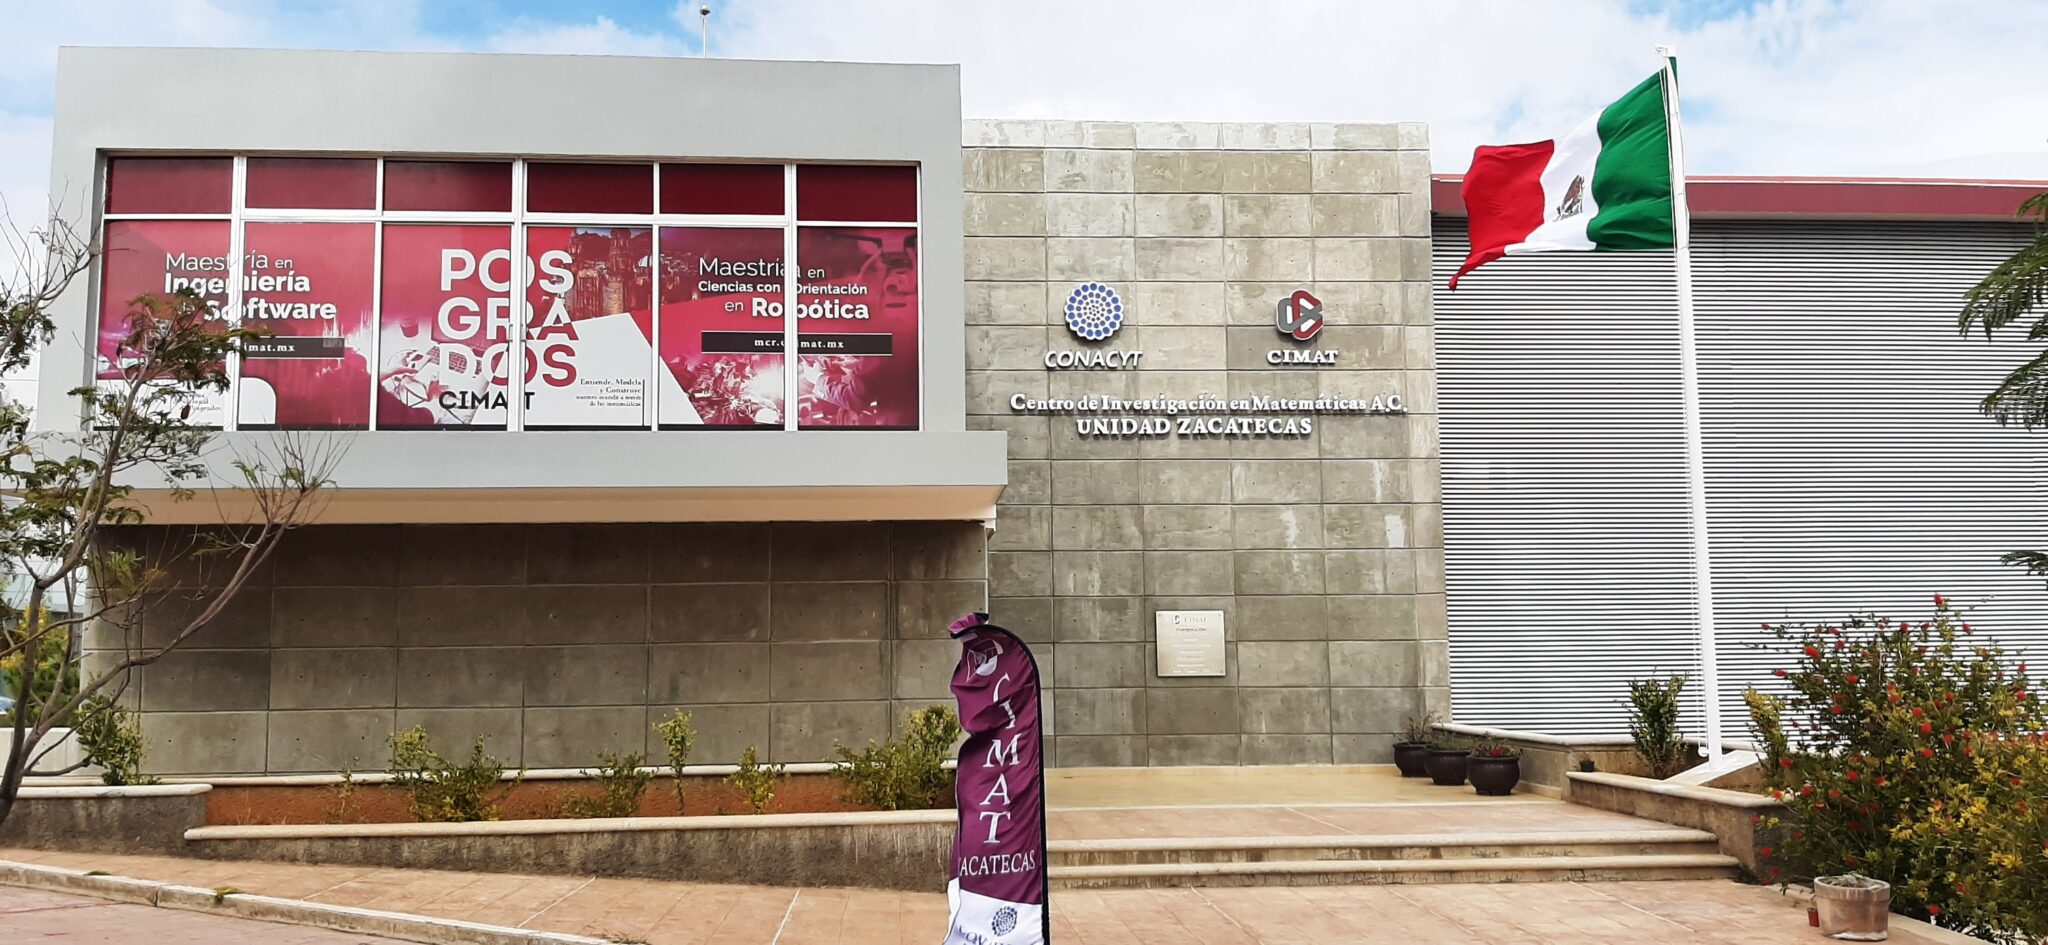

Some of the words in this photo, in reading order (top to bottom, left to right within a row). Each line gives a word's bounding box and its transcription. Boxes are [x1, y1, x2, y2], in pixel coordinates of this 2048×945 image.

[275, 258, 293, 269] en
[441, 248, 575, 294] POS
[699, 257, 801, 278] Maestría
[807, 267, 825, 279] en
[164, 270, 311, 298] Ingeniería
[698, 281, 753, 292] Ciencias
[756, 283, 781, 293] con
[204, 298, 337, 321] Software
[724, 301, 744, 312] en
[437, 296, 579, 340] GRA
[754, 338, 844, 348] mcr.cmat.mx
[439, 343, 577, 388] DOS
[1044, 350, 1144, 369] CONACYT
[1266, 349, 1338, 366] CIMAT
[439, 391, 535, 410] CIMAT
[1010, 393, 1074, 411] Centro
[1077, 395, 1098, 411] de
[1101, 394, 1227, 415] Investigación
[1230, 399, 1250, 410] en
[1251, 393, 1367, 411] Matemáticas
[1370, 395, 1408, 413] A.C.
[1077, 418, 1171, 435] UNIDAD
[1177, 417, 1312, 435] ZACATECAS
[980, 672, 1022, 844] CIMAT
[959, 849, 1036, 876] ACATECAS
